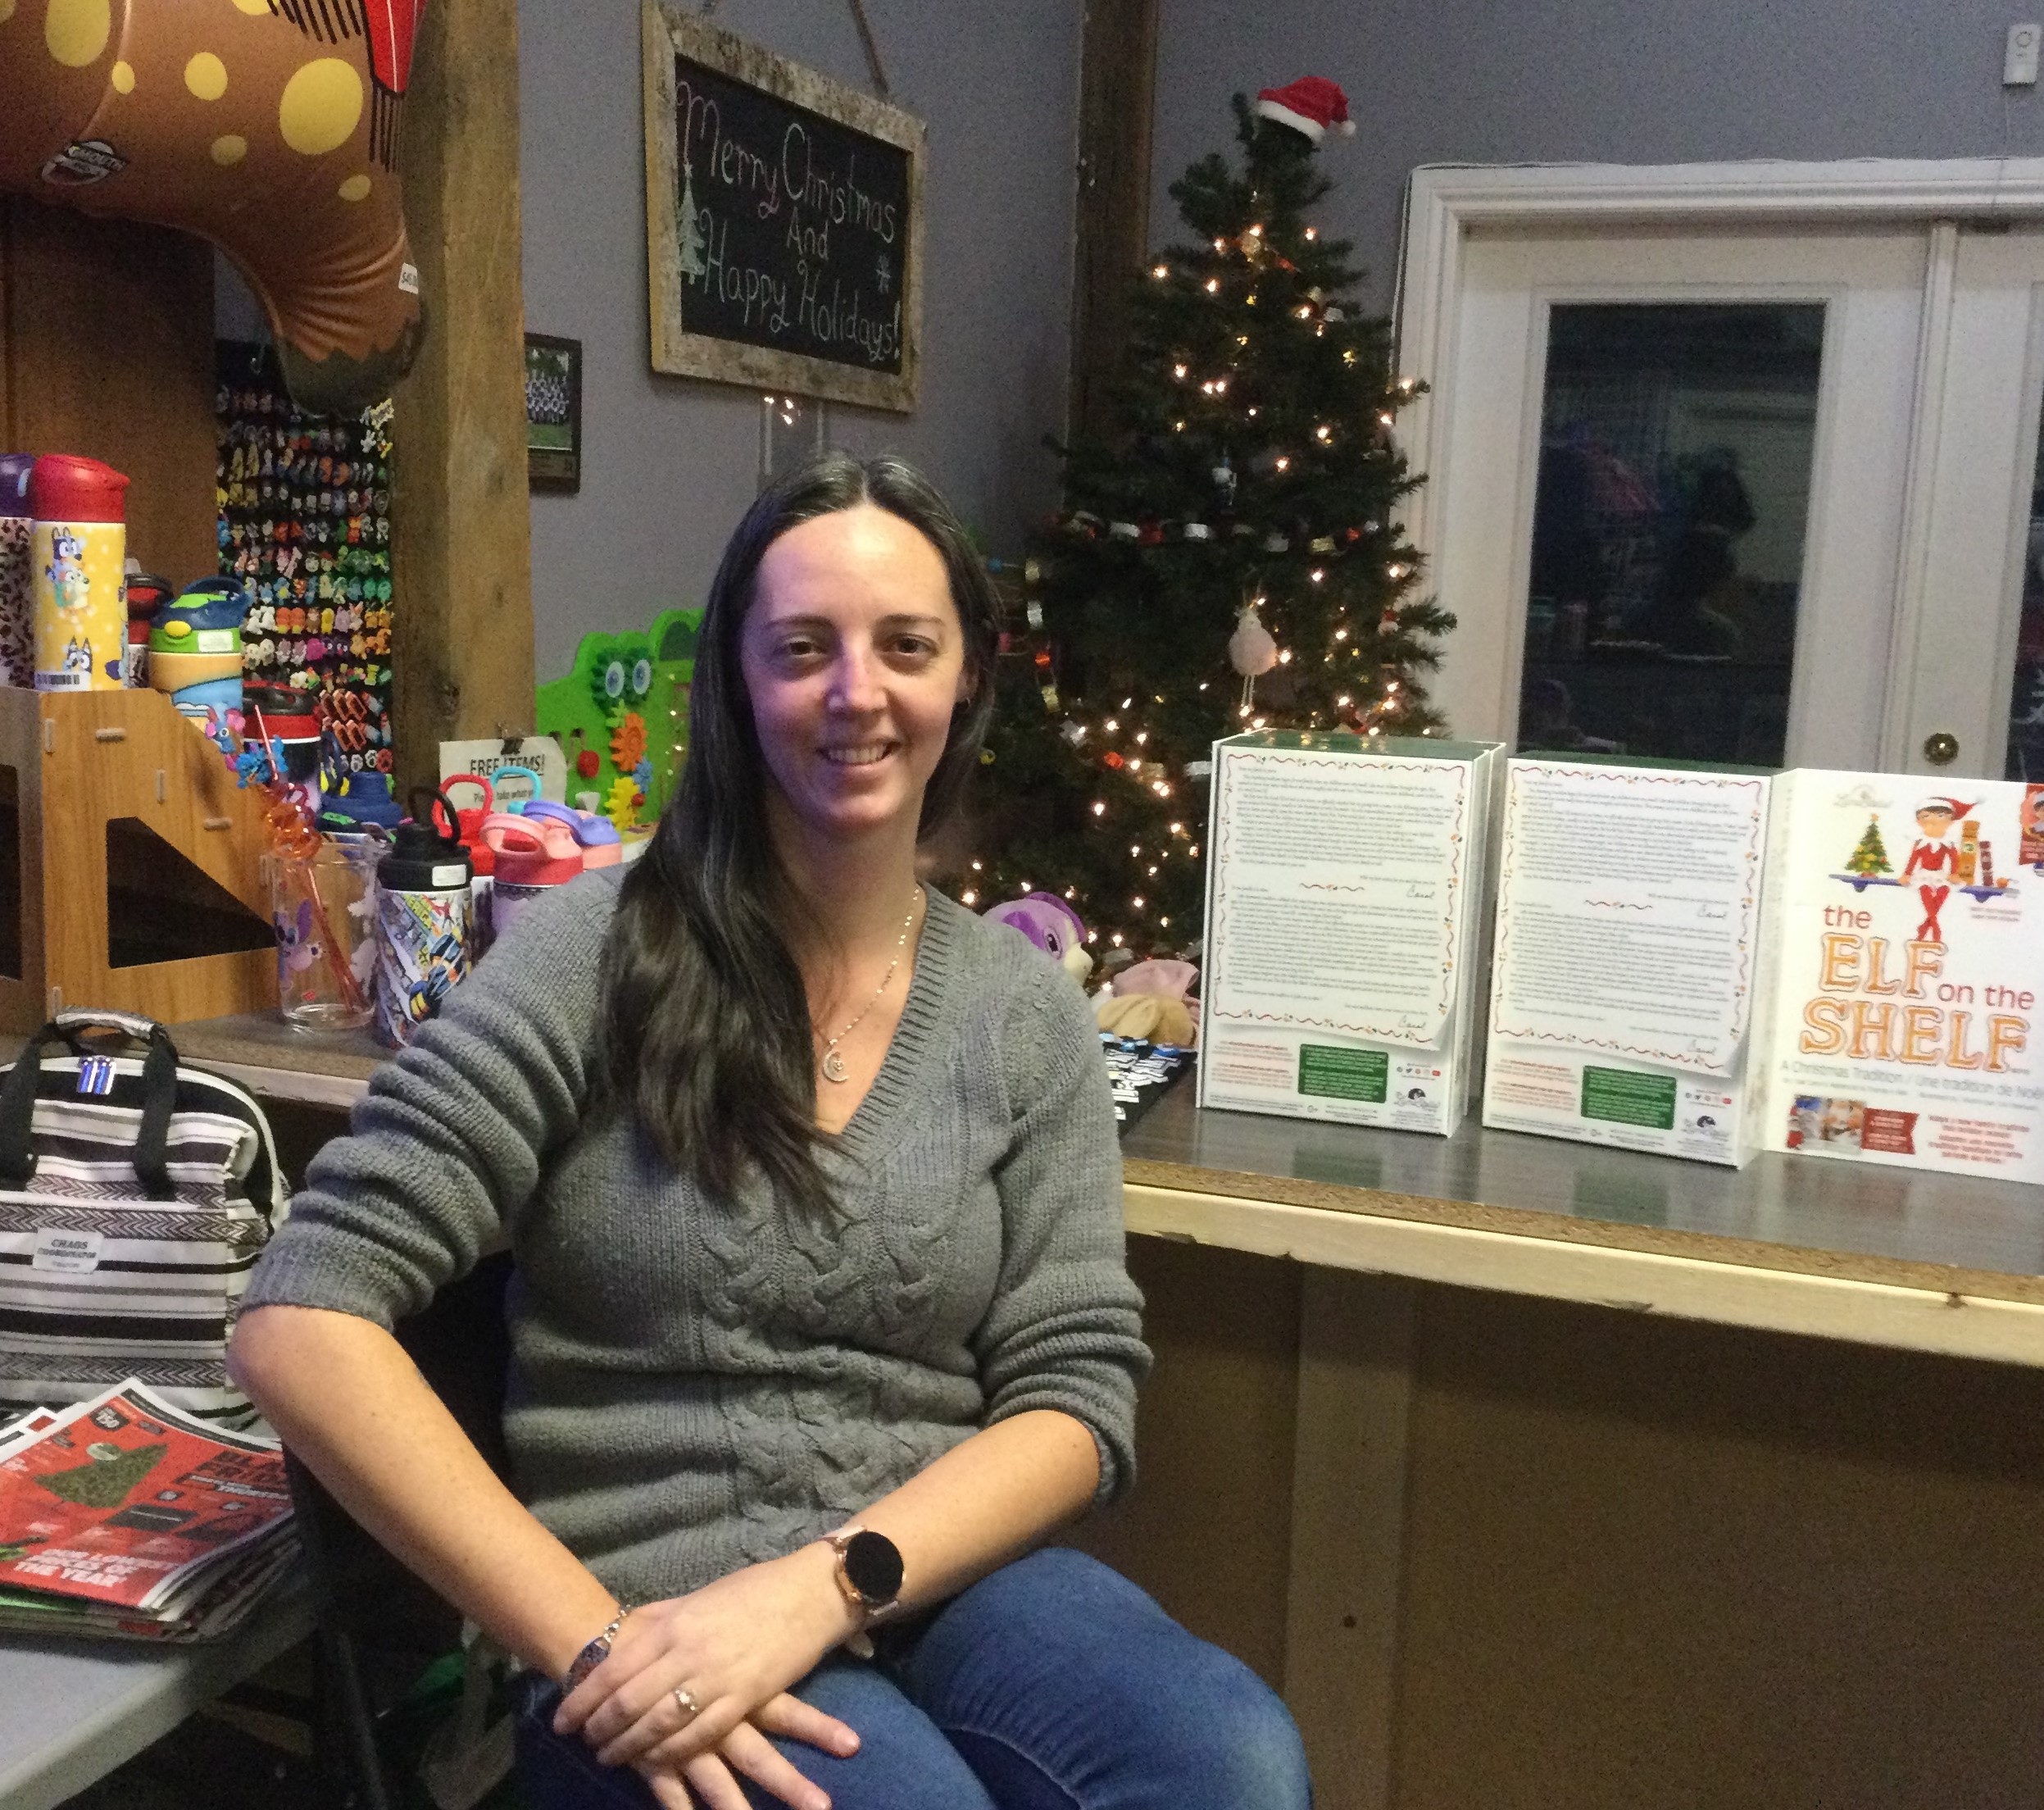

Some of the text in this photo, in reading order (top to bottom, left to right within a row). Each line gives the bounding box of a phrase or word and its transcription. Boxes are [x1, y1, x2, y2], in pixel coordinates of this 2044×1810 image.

[676, 81, 896, 243] Merry Christmas
[787, 207, 829, 261] And
[698, 208, 902, 362] Happy Holidays!
[470, 757, 499, 776] FREE
[1822, 905, 1872, 929] the
[1819, 932, 1949, 999] ELF
[1937, 983, 2035, 1010] on the
[1799, 996, 2031, 1073] SHELF
